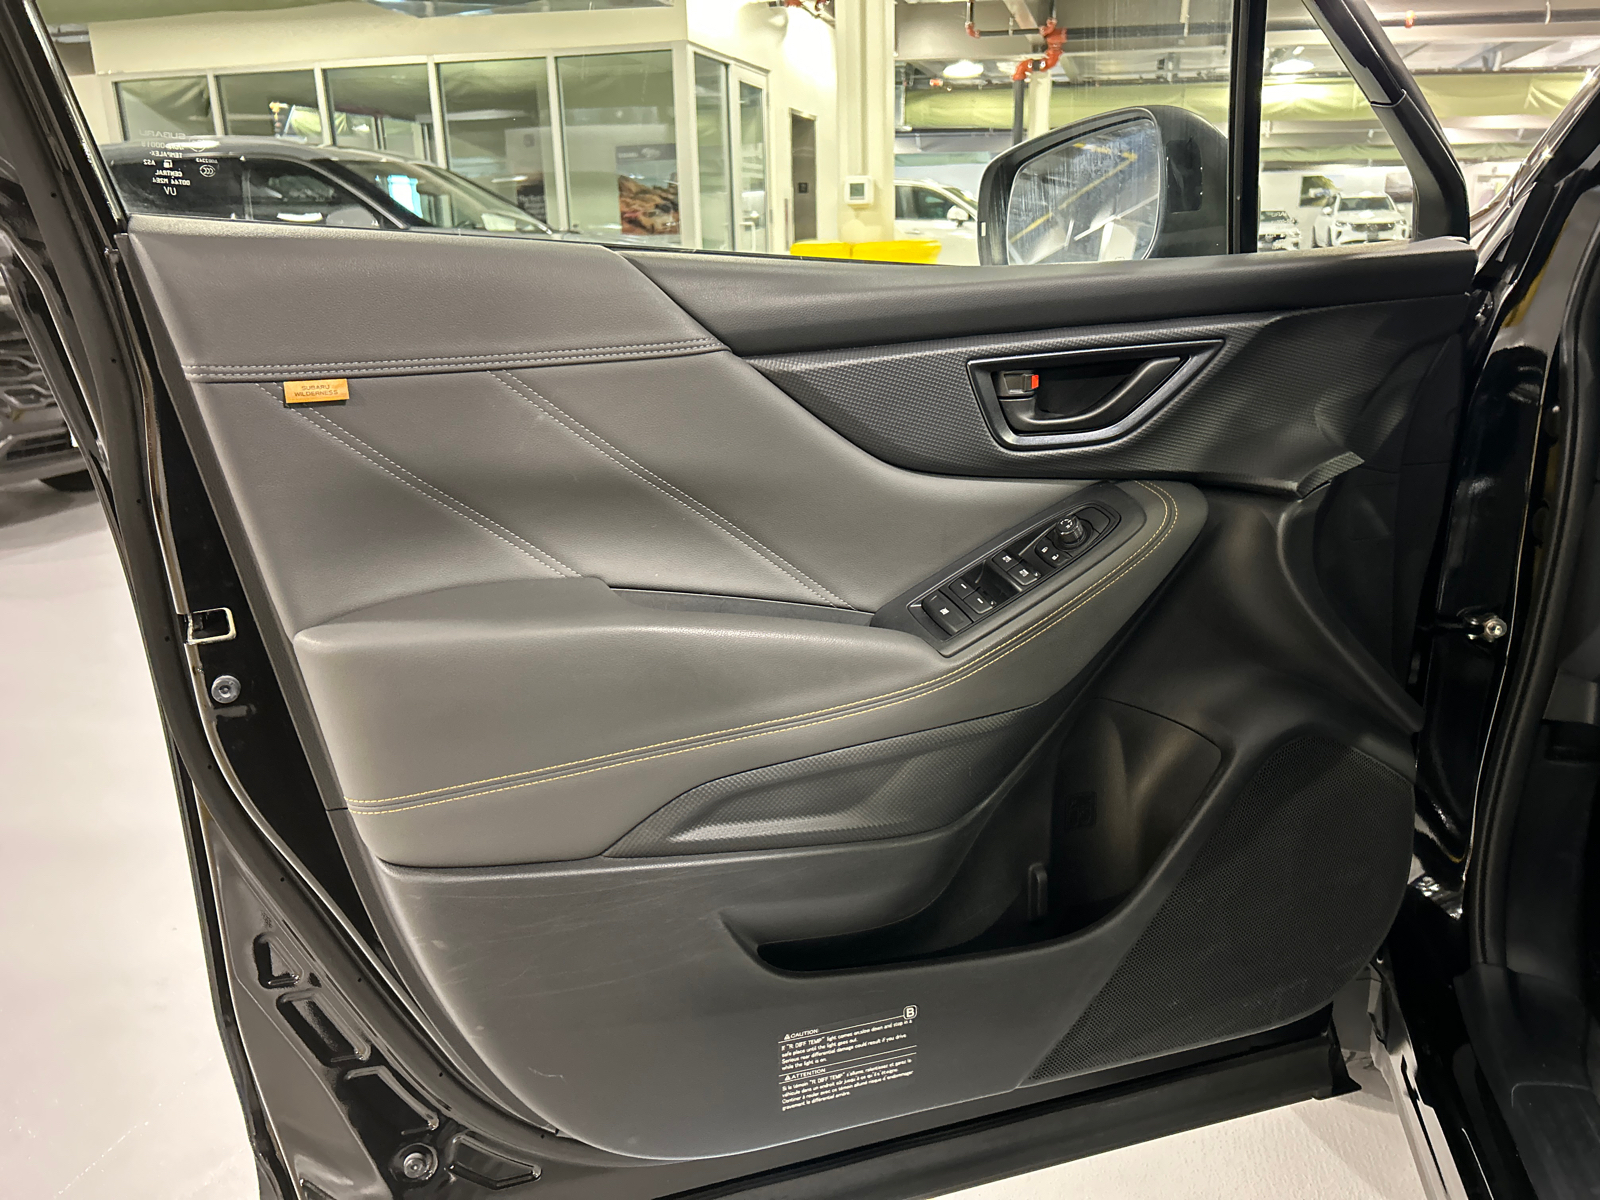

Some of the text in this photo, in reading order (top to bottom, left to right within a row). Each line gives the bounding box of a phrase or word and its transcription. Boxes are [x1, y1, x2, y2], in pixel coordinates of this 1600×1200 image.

[906, 1007, 915, 1018] B
[790, 1028, 819, 1038] CAUTION
[811, 1049, 836, 1058] differential
[837, 1044, 854, 1052] damage
[791, 1068, 826, 1080] ATTENTION
